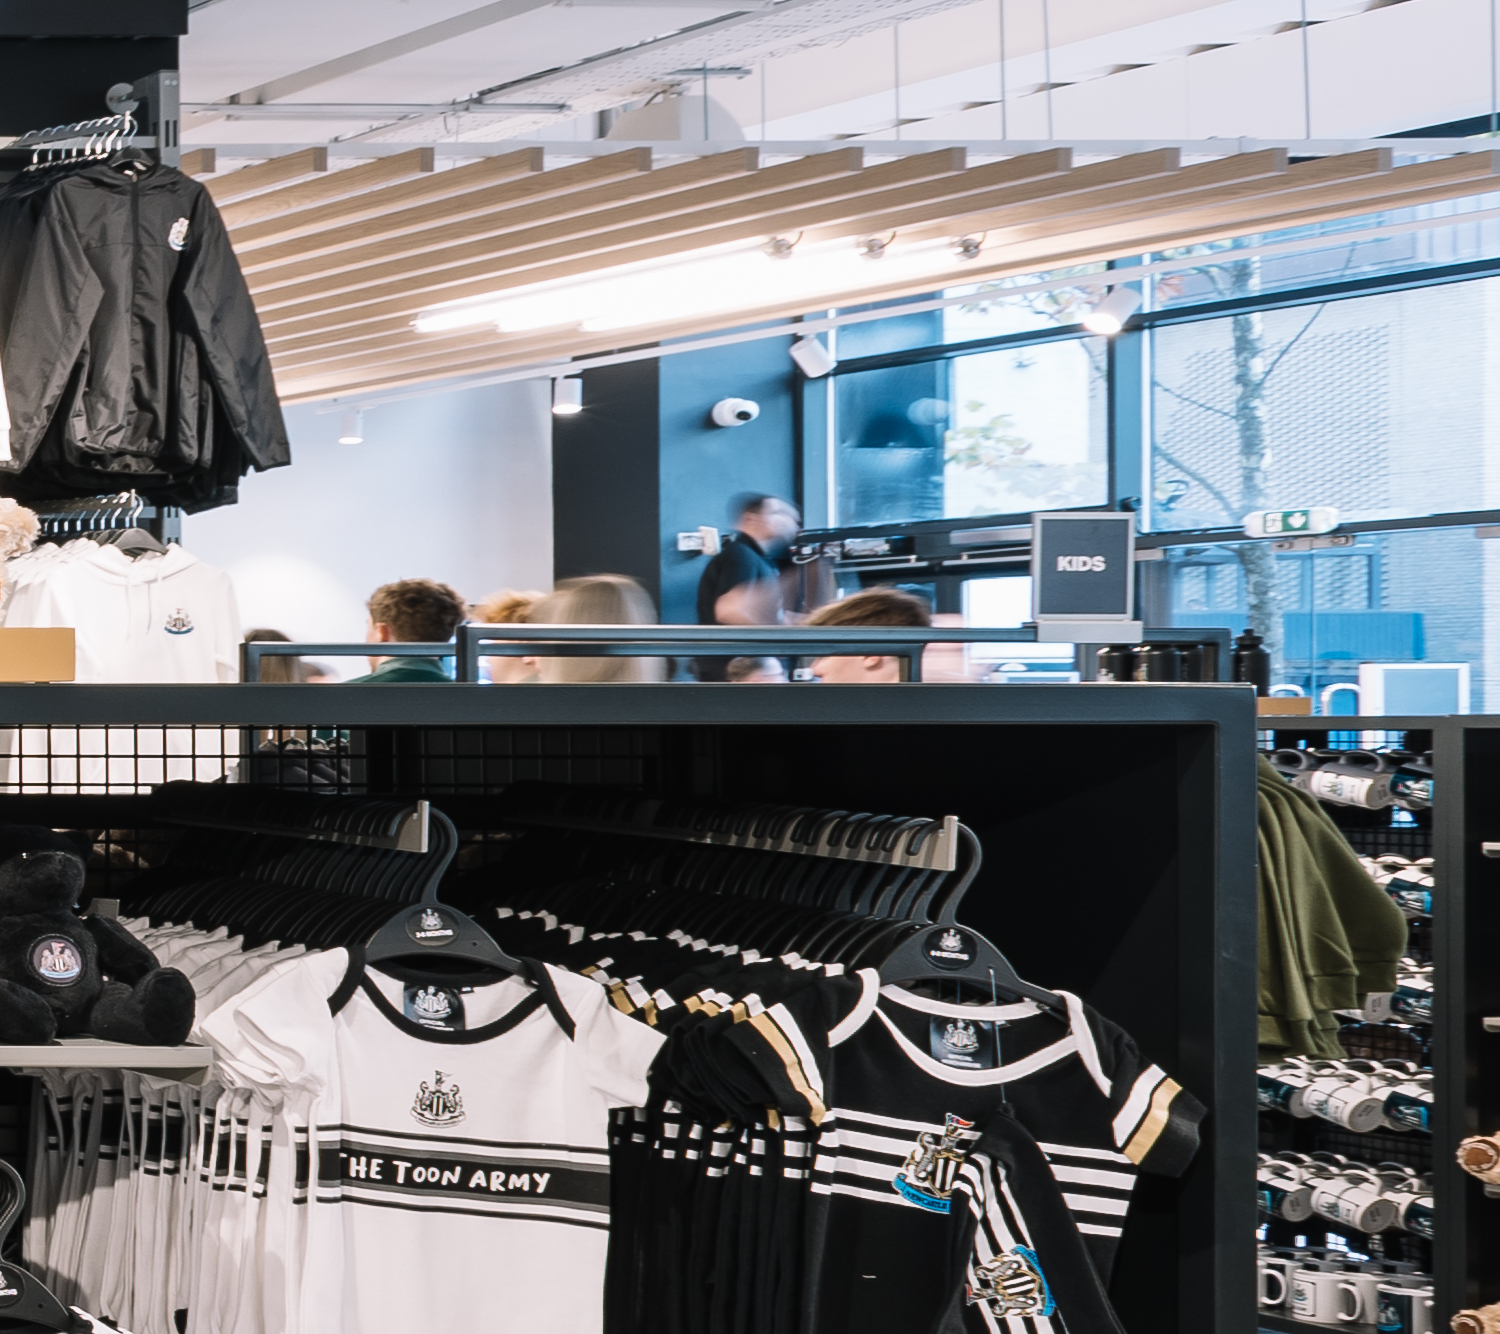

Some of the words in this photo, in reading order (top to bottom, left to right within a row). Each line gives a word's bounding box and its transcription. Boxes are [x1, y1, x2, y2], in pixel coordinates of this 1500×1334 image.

[1056, 555, 1106, 572] KIDS
[339, 1152, 384, 1179] HE
[392, 1160, 462, 1186] TOON
[468, 1170, 551, 1194] ARMY
[904, 1189, 948, 1210] NEWCASTLE
